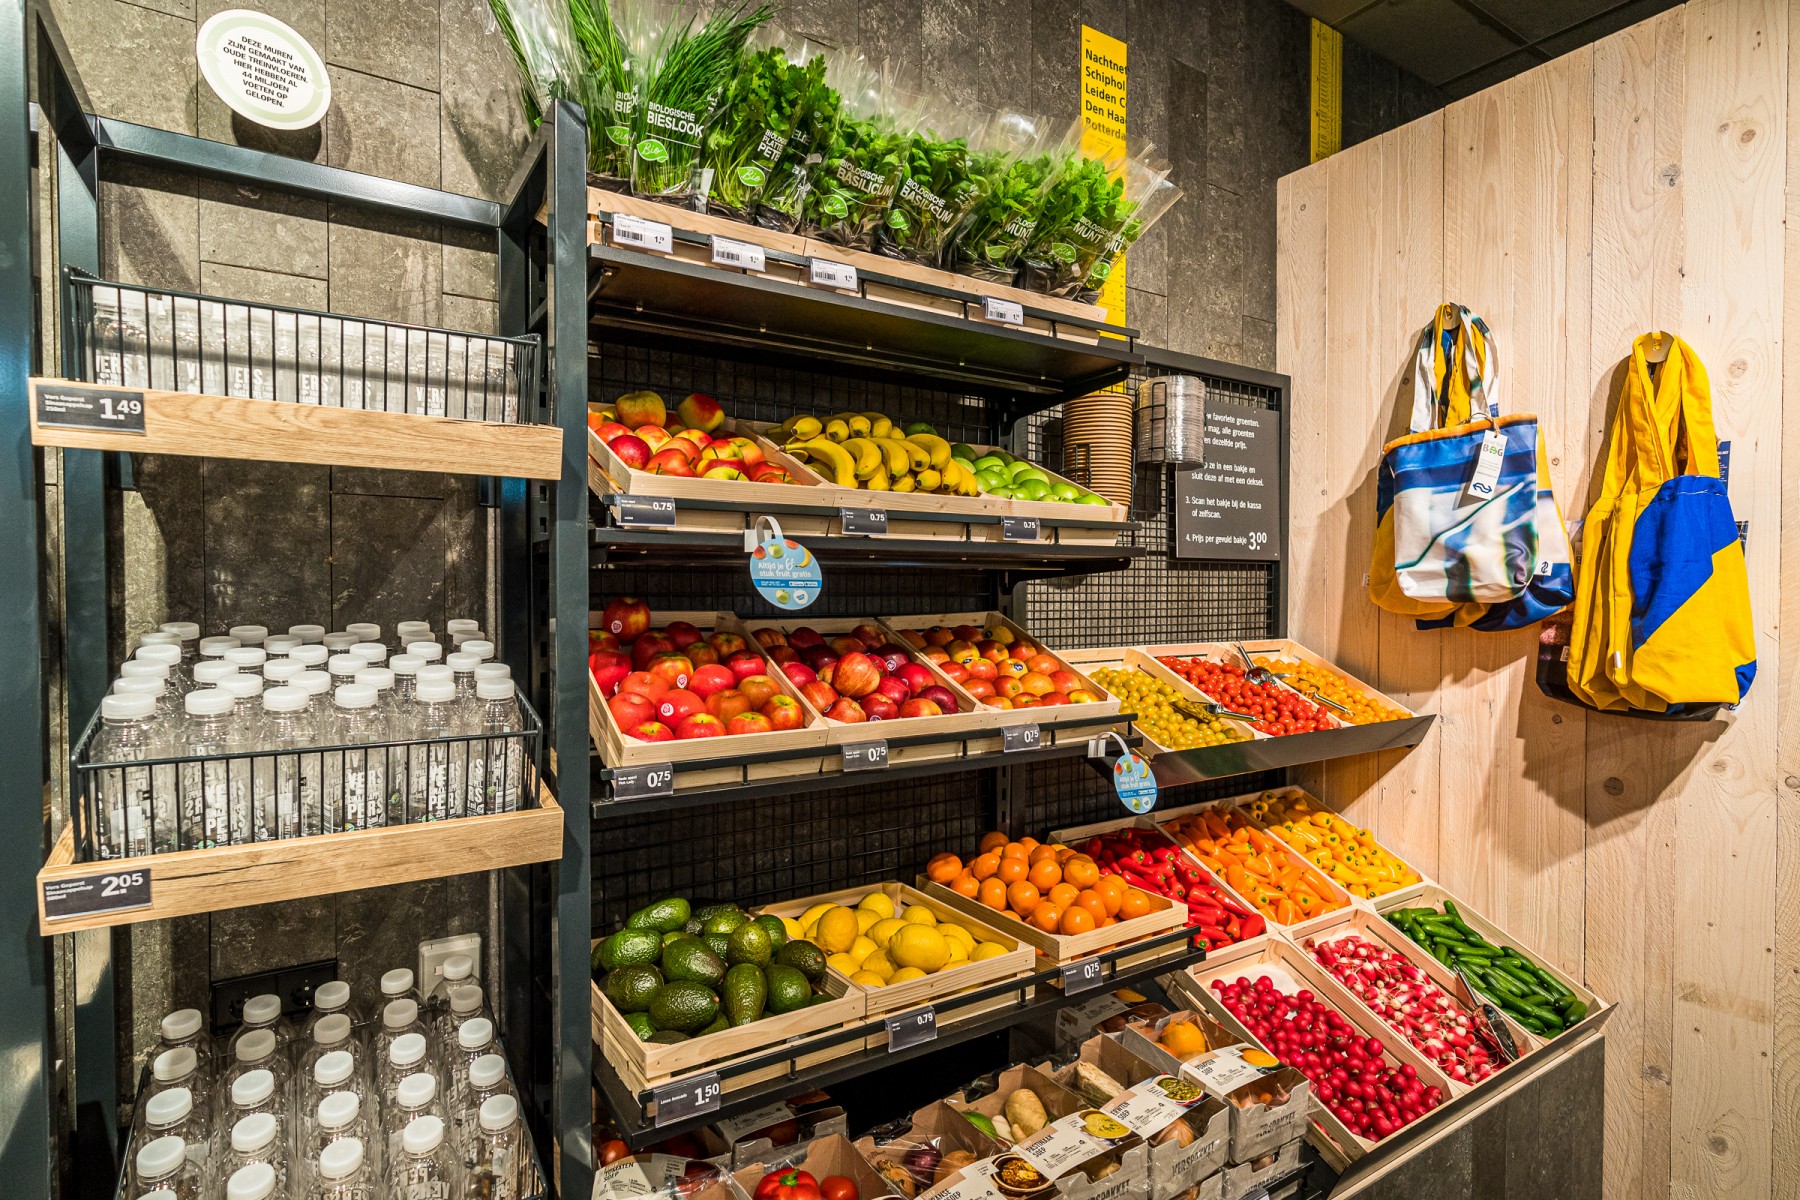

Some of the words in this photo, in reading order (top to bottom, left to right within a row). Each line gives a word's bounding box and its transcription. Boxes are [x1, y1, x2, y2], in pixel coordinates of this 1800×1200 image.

[227, 39, 246, 52] ZIJN
[248, 47, 287, 66] GEMAAKT
[289, 62, 305, 74] VAN
[241, 36, 262, 49] DEZE
[264, 44, 293, 61] MUREN
[223, 46, 246, 60] OUDE
[248, 56, 309, 83] TREINVLOEREN.
[233, 59, 253, 71] HIER
[254, 66, 286, 83] HEBBEN
[287, 78, 298, 88] AL
[242, 71, 252, 79] 44
[254, 76, 290, 93] MILJOEN
[1085, 65, 1125, 91] Schiphol
[242, 79, 275, 96] VOETEN
[276, 91, 288, 100] OP
[1085, 82, 1116, 104] Leiden
[245, 89, 285, 108] GELOPEN.
[648, 101, 696, 122] BIOLOGISCHE
[1085, 100, 1104, 116] Den
[647, 110, 705, 138] BIESLOOK
[642, 142, 662, 155] Bio
[741, 169, 761, 182] Bio
[841, 159, 885, 184] BIOLOGISCHE
[837, 167, 895, 197] BASILICUM
[906, 177, 947, 208] BIOLOGISCHE
[900, 185, 954, 223] BASILICUM
[1073, 222, 1104, 244] MUNT
[99, 398, 142, 420] 1.49
[1213, 413, 1235, 424] favoriete
[1236, 416, 1260, 428] groenten.
[1222, 427, 1231, 435] alle
[1232, 429, 1255, 439] groenten
[1211, 438, 1234, 448] dezelfde
[1234, 440, 1247, 450] prijs.
[1216, 462, 1222, 470] in
[1222, 464, 1233, 472] een
[1233, 463, 1248, 474] bakje
[1248, 466, 1255, 474] en
[1191, 472, 1203, 481] sluit
[1204, 473, 1217, 482] deze
[1217, 474, 1224, 482] af
[1224, 475, 1235, 484] met
[1235, 477, 1246, 485] een
[1246, 476, 1264, 486] deksel.
[653, 502, 672, 511] 0.75
[1185, 496, 1191, 504] 3.
[1191, 496, 1205, 505] Scan
[1206, 497, 1215, 506] het
[1216, 498, 1231, 509] bakje
[1231, 499, 1239, 509] bij
[1239, 500, 1246, 509] de
[1247, 500, 1262, 510] kassa
[870, 513, 885, 521] 0.75
[1191, 509, 1198, 517] of
[1199, 509, 1221, 519] zelfscan.
[1023, 521, 1036, 529] 0.75
[1185, 533, 1191, 542] 4.
[1192, 533, 1204, 543] Prijs
[1205, 535, 1214, 544] per
[1215, 535, 1232, 545] gevuld
[1233, 535, 1247, 546] bakje
[1248, 532, 1267, 550] 3.00
[758, 562, 776, 571] Altijd
[777, 563, 784, 571] je
[1024, 730, 1039, 743] 0.75
[868, 746, 886, 761] 0.75
[647, 771, 671, 788] 0.75
[101, 873, 143, 897] 2.05
[1084, 962, 1100, 978] 0.75
[917, 1012, 933, 1025] 0.79
[694, 1083, 719, 1106] 1.50
[1110, 1102, 1130, 1117] ERWTEN
[1118, 1109, 1130, 1120] SOEP
[1025, 1134, 1054, 1153] PASTINAAK
[1032, 1147, 1046, 1157] SOEP
